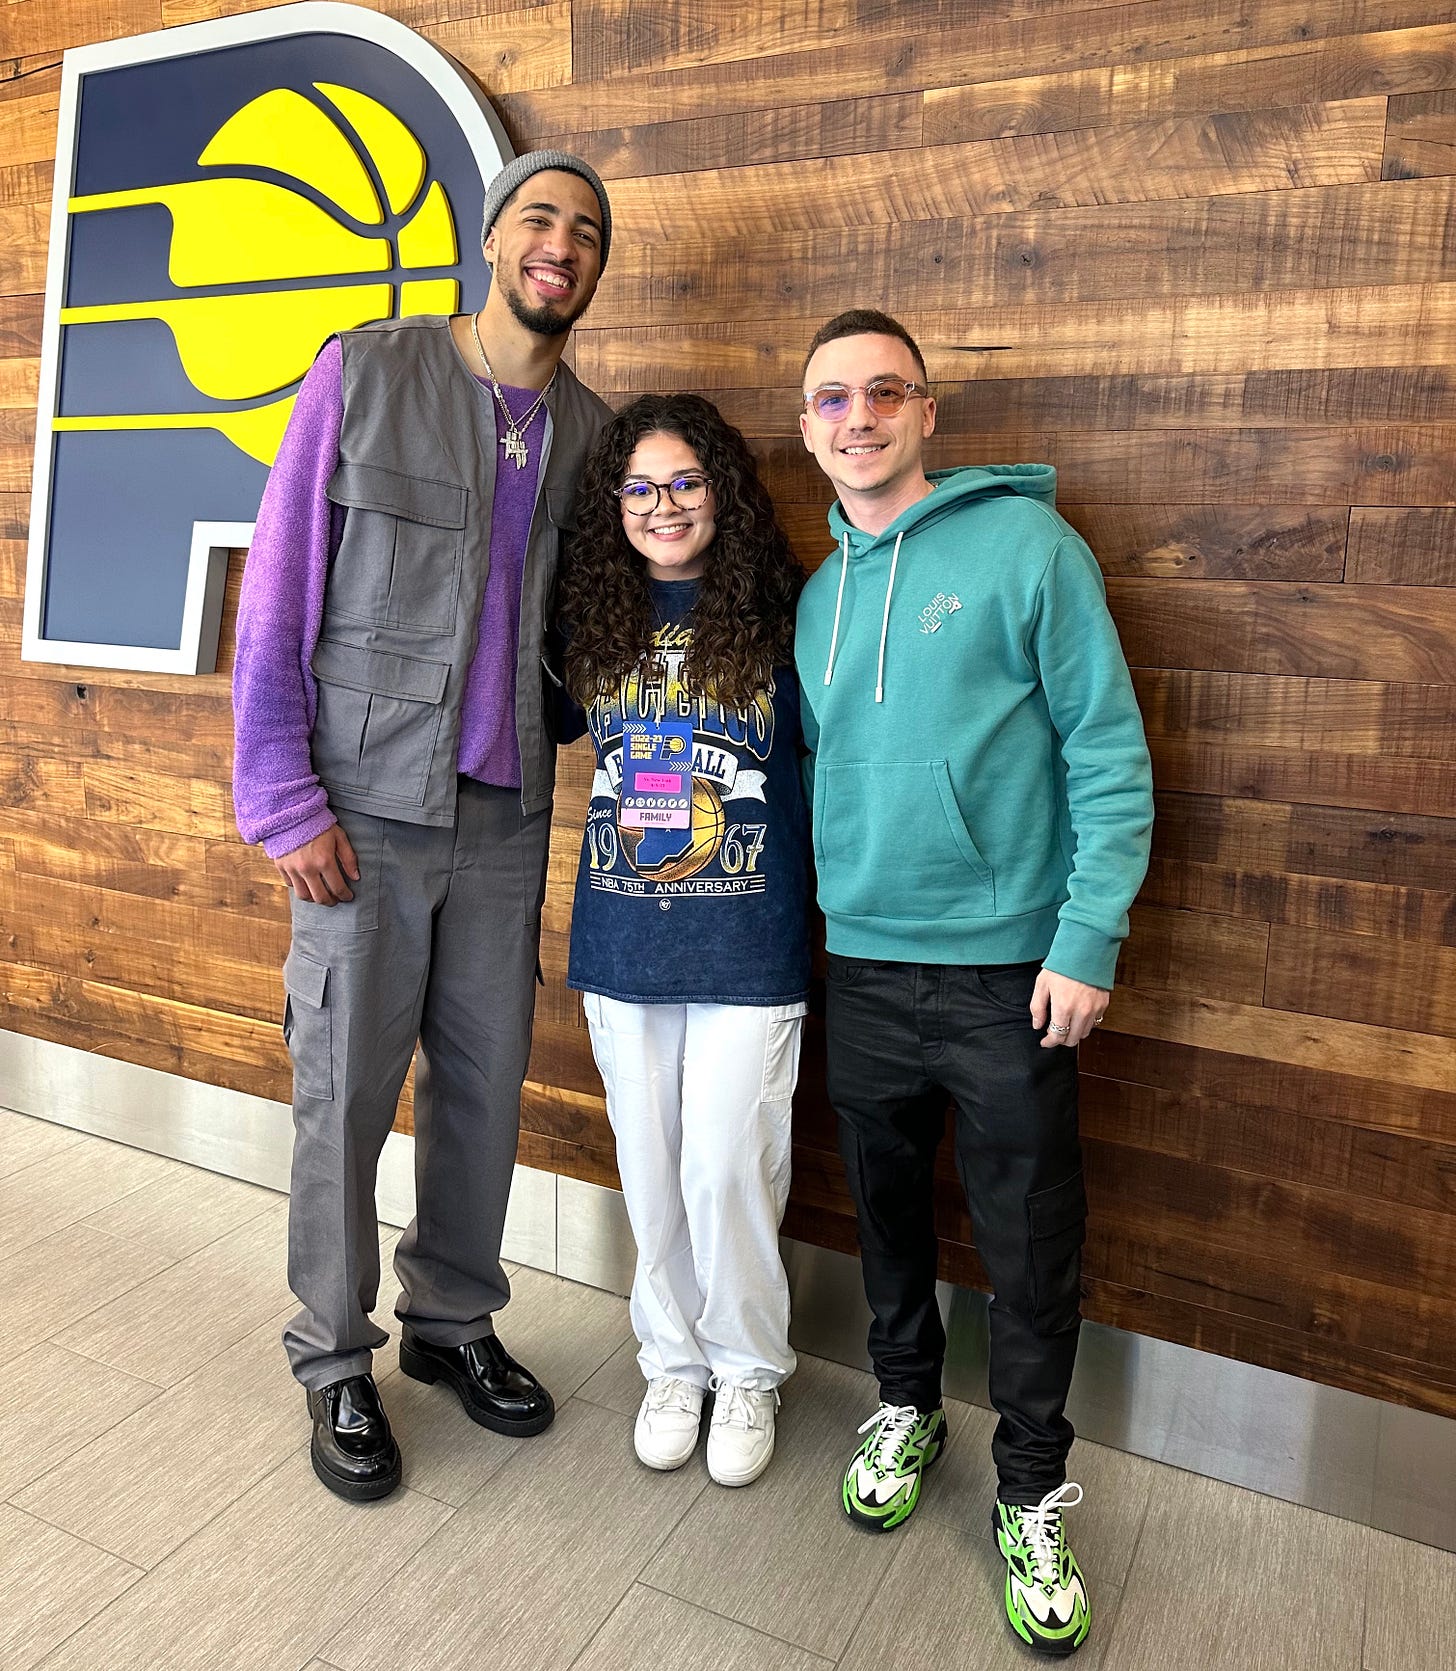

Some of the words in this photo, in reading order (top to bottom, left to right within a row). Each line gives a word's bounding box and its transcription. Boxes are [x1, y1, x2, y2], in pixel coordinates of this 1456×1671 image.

[918, 592, 945, 623] LOUIS
[919, 592, 960, 635] VUITTON
[630, 734, 663, 744] 2022-23
[630, 743, 657, 752] SINGLE
[630, 751, 653, 760] GAME
[587, 806, 613, 823] Since
[640, 812, 672, 822] FAMILY
[602, 878, 620, 891] NBA
[622, 880, 645, 894] 75TH
[654, 879, 749, 894] ANNIVERSARY
